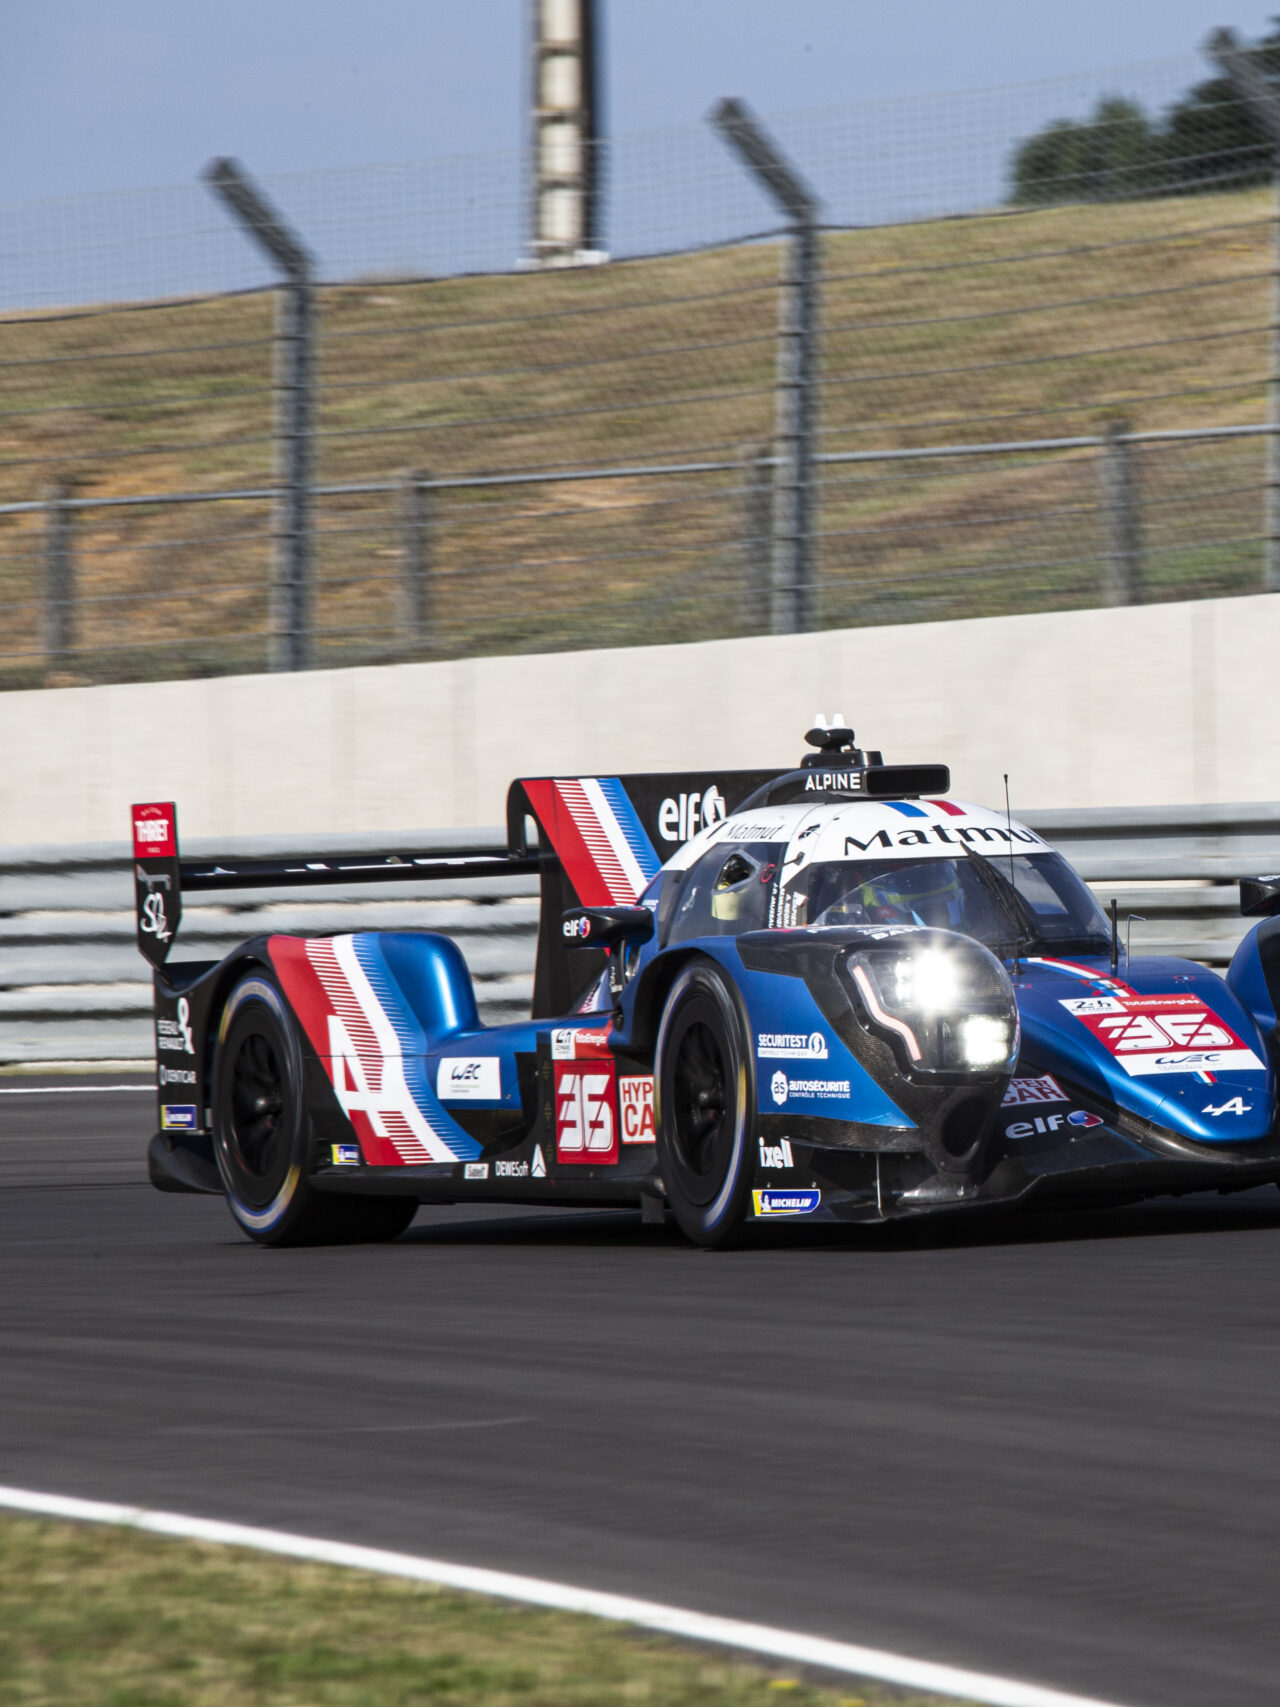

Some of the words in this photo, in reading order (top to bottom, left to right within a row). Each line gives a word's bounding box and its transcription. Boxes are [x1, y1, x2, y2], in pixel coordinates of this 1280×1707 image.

[804, 773, 861, 791] ALPINE
[658, 792, 701, 841] elf
[727, 824, 785, 840] Matmut
[562, 920, 581, 937] elf
[1121, 998, 1202, 1008] TotalEnergies
[757, 1033, 808, 1048] SECURITEST
[1097, 1013, 1234, 1051] 36
[1154, 1053, 1221, 1065] WEC
[451, 1063, 482, 1081] WEC
[557, 1074, 614, 1152] 36
[1004, 1114, 1065, 1139] elf
[758, 1136, 795, 1169] ixell
[494, 1160, 530, 1177] DEWESoft
[770, 1198, 812, 1208] MICHELIN
